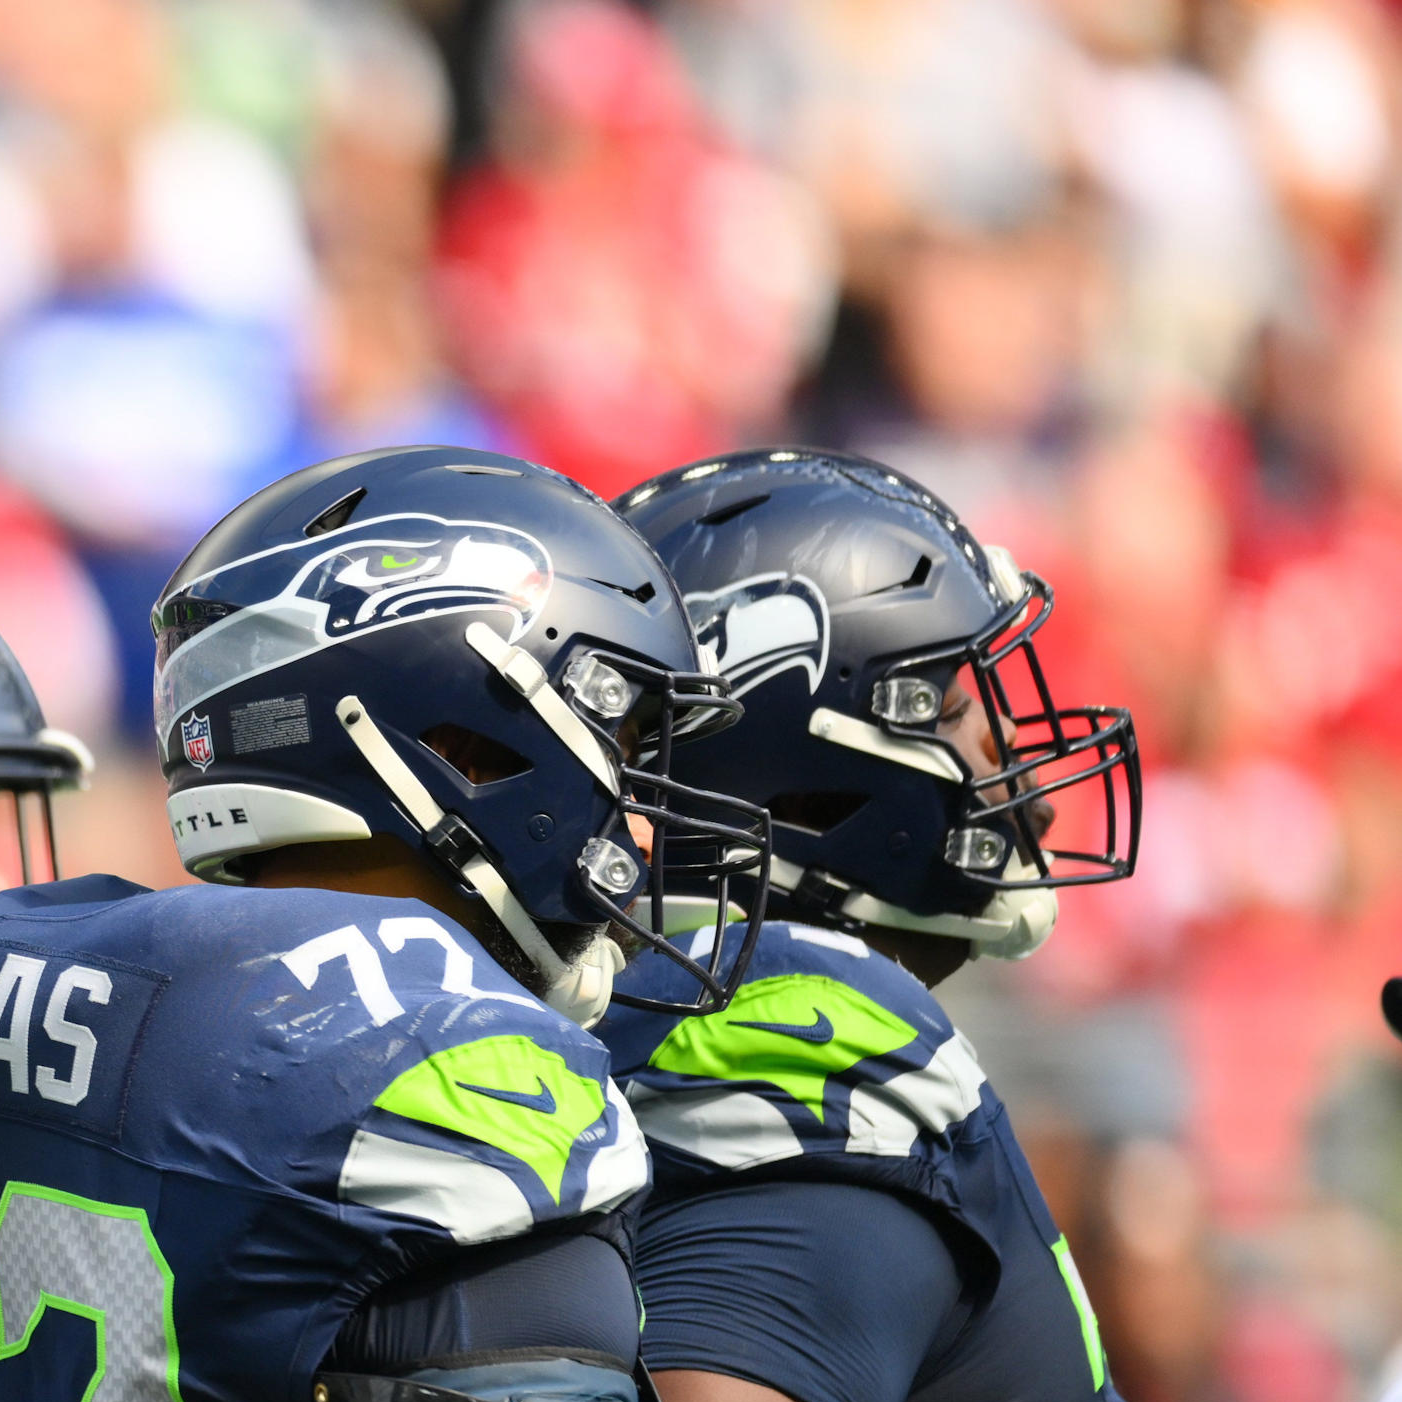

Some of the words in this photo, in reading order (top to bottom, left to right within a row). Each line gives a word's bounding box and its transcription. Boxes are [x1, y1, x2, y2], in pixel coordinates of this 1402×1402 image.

[187, 738, 211, 762] NFL
[173, 808, 248, 838] TTLE
[280, 916, 547, 1028] 72
